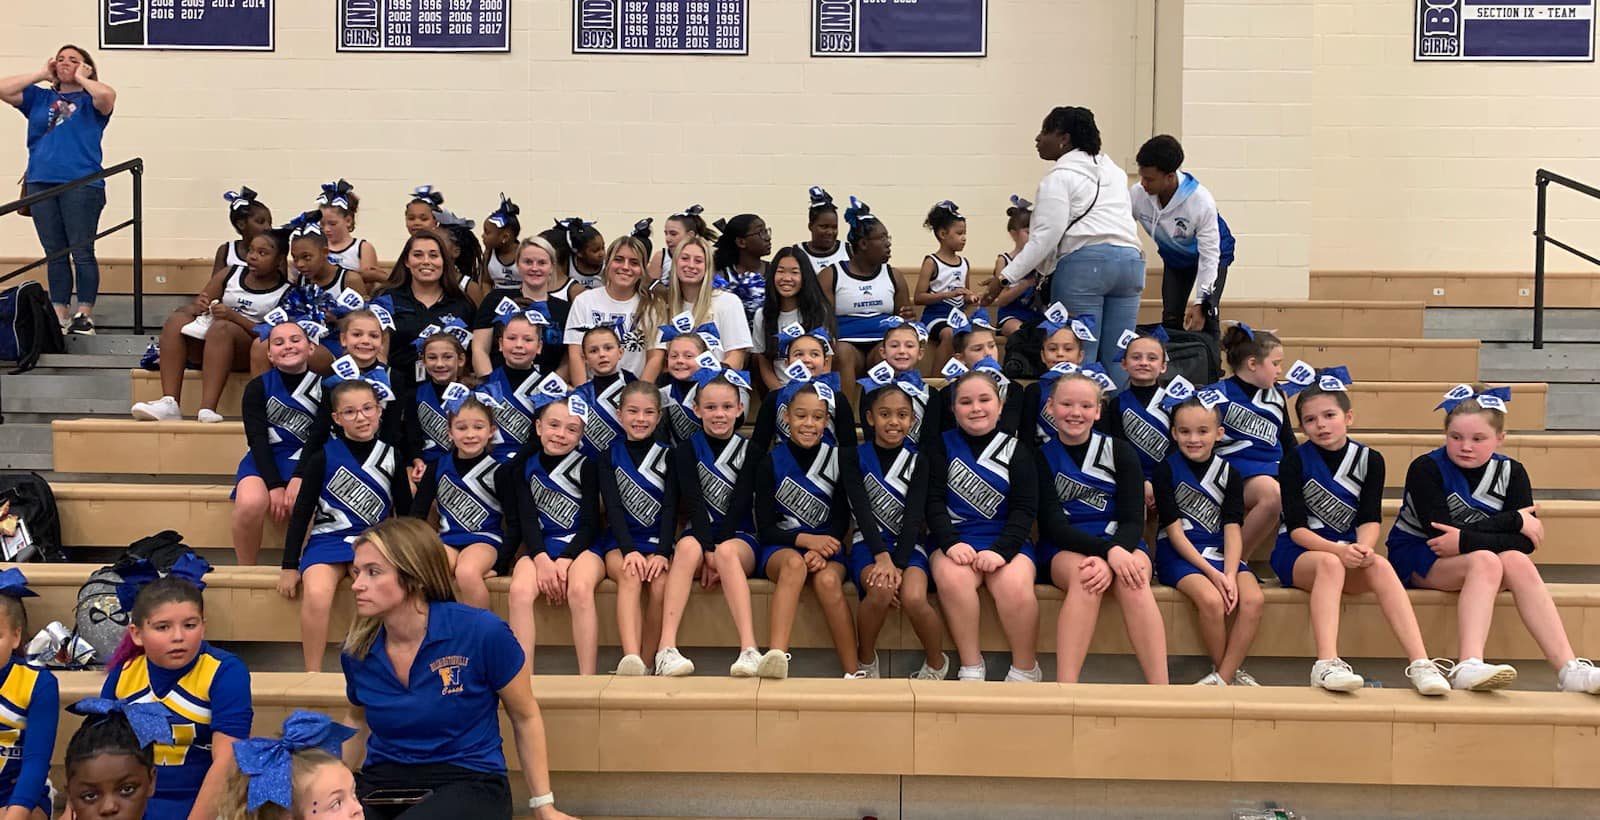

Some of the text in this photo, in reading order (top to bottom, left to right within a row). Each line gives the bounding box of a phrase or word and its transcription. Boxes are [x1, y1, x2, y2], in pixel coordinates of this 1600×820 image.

[150, 9, 204, 19] 2016 2017
[388, 0, 503, 10] 1995 1996 1997 2000
[625, 2, 740, 13] 1987 1988 1989 1991
[1477, 8, 1519, 18] SECTION
[1523, 8, 1535, 18] IX
[1547, 8, 1576, 18] TEAM
[388, 11, 503, 22] 2002 2005 2006 2010
[625, 14, 740, 25] 1992 1993 1994 1995
[345, 28, 379, 46] GIRLS
[388, 23, 502, 34] 2011 2015 2016 2017
[625, 25, 739, 36] 1996 1997 2001 2010
[388, 35, 412, 46] 2018
[582, 30, 614, 48] BOYS
[624, 37, 740, 48] 2011 2012 2015 2018
[821, 33, 852, 51] BOYS
[1422, 37, 1457, 56] GIRLS
[1224, 403, 1277, 446] WALLKILL
[1122, 408, 1169, 461] WALLKILL
[328, 468, 384, 525] WALLKILL
[946, 460, 1003, 517] WALLKILL
[436, 477, 488, 531] WALLKILL
[531, 476, 579, 528] WALLKILL
[614, 469, 659, 527] WALLKILL
[775, 478, 829, 527] WALLKILL
